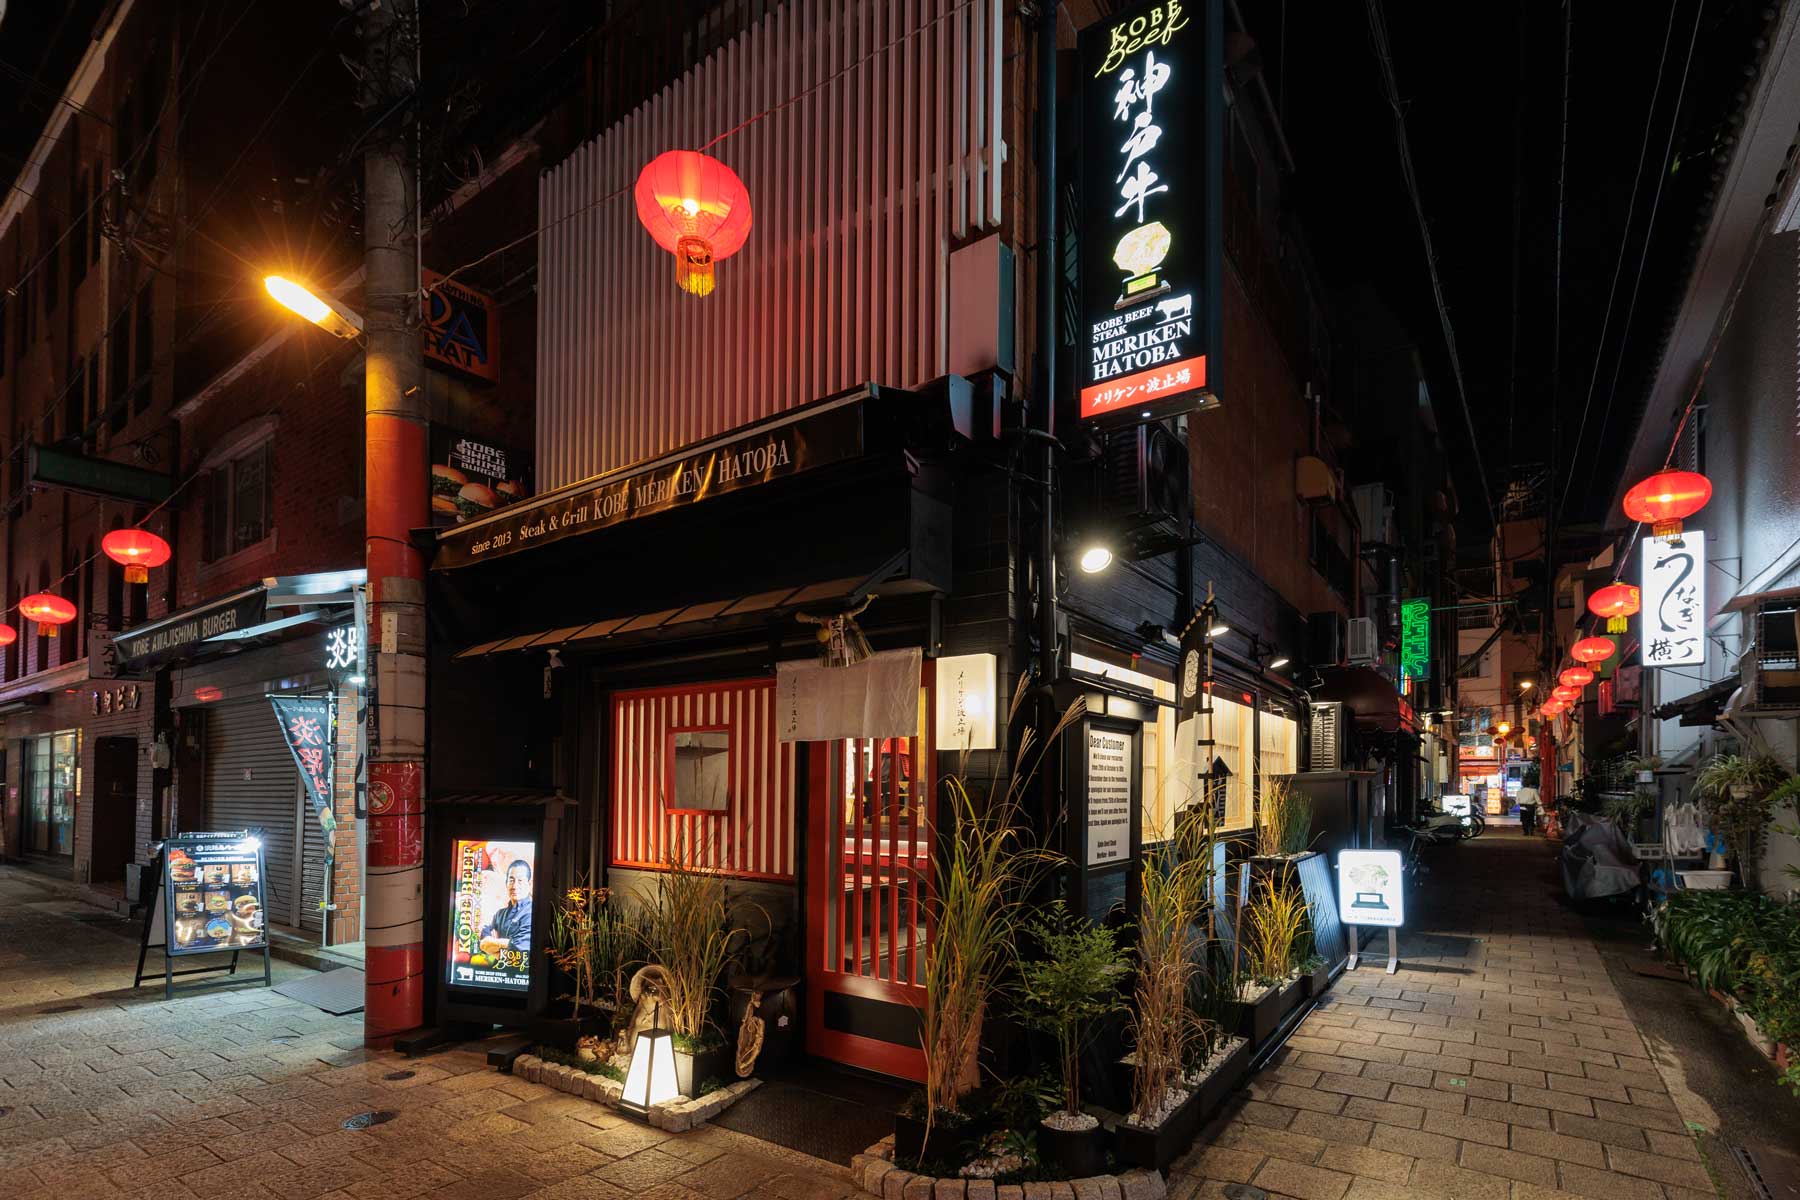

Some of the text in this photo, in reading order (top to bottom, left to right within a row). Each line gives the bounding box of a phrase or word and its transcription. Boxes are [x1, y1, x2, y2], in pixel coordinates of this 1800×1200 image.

[1095, 7, 1189, 78] Beef
[1111, 0, 1179, 47] KOBE
[1114, 51, 1170, 223] 神戸牛
[1092, 318, 1192, 363] MERIKEN
[1093, 306, 1154, 333] KOBE BEEF
[1093, 325, 1127, 343] STEAK
[1093, 342, 1180, 380] HATOBA
[461, 439, 505, 458] KOBE
[472, 439, 790, 554] since 2013 Steak & Grill KOBE MERIKEN HATOBA
[132, 640, 150, 656] KOBE
[152, 622, 199, 652] AWAJISHIMA
[203, 608, 237, 637] BURGER
[1090, 735, 1102, 749] Dear
[458, 846, 475, 953] KOBE BEEF
[500, 948, 529, 960] KOBE
